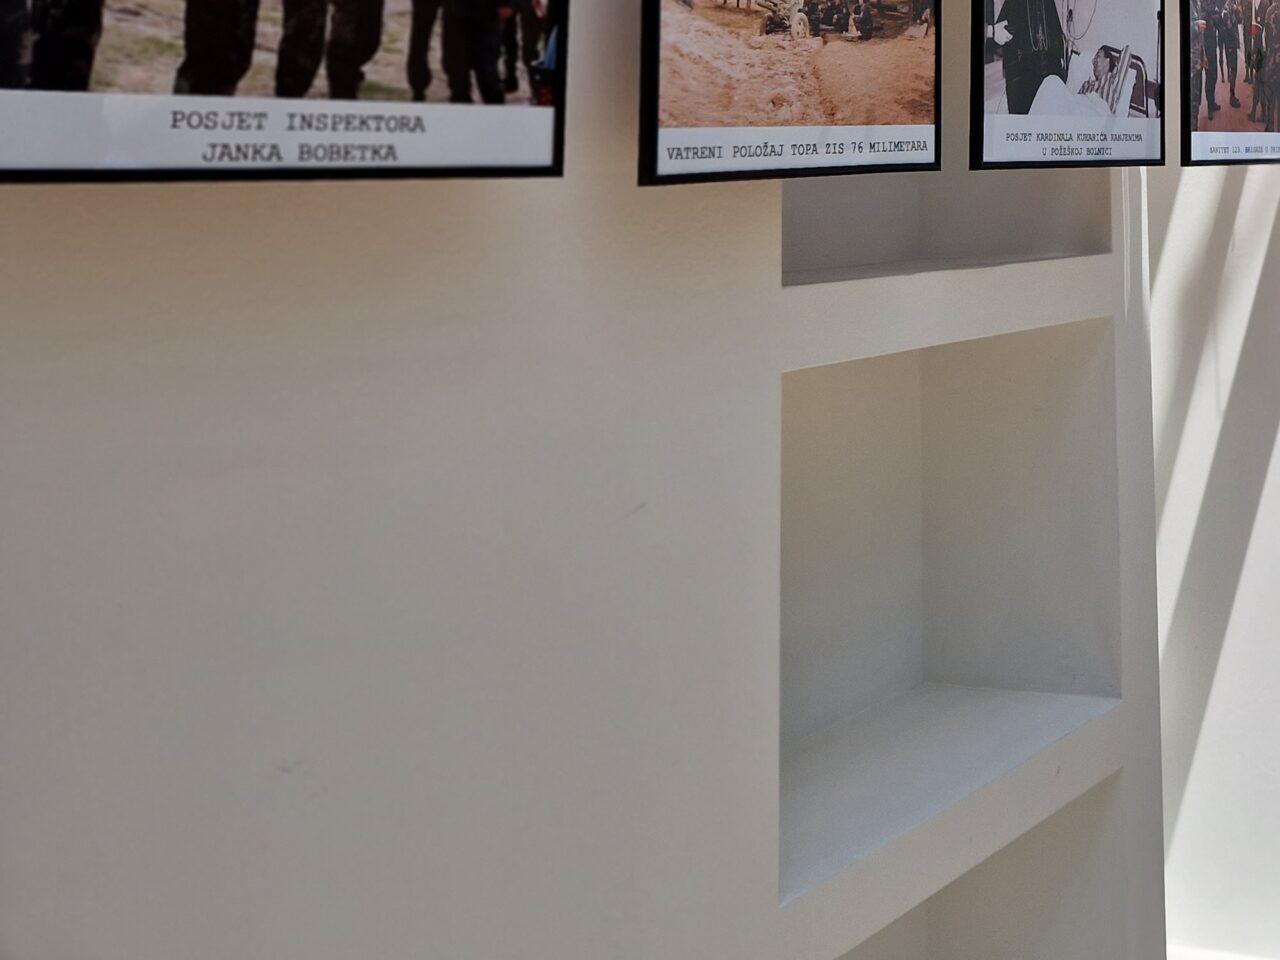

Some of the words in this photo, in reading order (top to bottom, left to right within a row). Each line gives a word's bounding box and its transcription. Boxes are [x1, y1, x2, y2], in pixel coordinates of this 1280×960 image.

[171, 110, 268, 130] POSJET
[286, 112, 426, 133] INSPEKTORA
[1005, 132, 1033, 142] POSJET
[1036, 132, 1073, 142] KARDINALA
[202, 143, 283, 162] JANKA
[298, 143, 398, 162] BOBETKA
[666, 146, 723, 160] VATRENI
[732, 142, 784, 158] POLOŽAJ
[790, 143, 818, 156] TOPA
[825, 143, 844, 155] ZIS
[851, 142, 864, 154] 76
[868, 140, 928, 153] MILIMETARA
[1050, 146, 1083, 156] POŽEŠKOJ
[1086, 147, 1113, 156] BOLNICI
